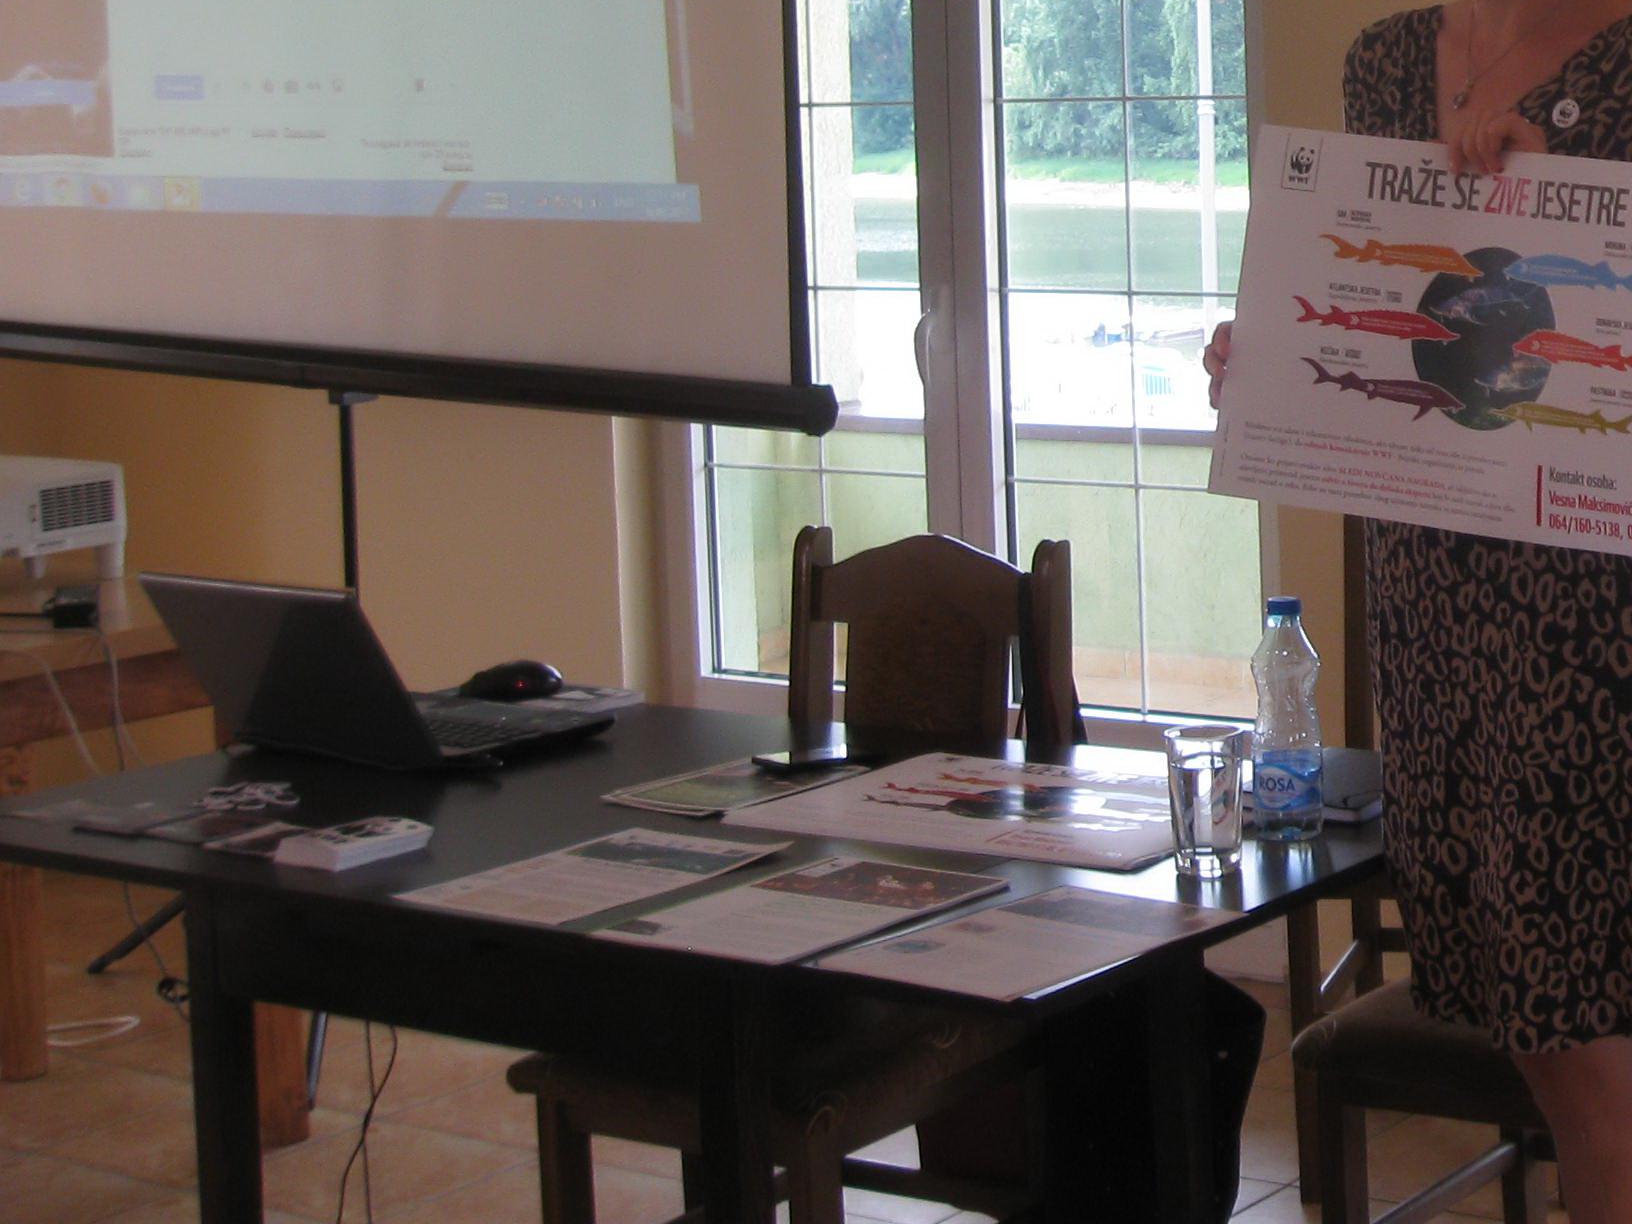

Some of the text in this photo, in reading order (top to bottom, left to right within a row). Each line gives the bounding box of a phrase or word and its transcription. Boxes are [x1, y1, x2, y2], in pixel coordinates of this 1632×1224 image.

[1365, 158, 1448, 207] TRAŽE
[1452, 173, 1484, 211] SE
[1530, 179, 1630, 227] JESETRE
[1550, 466, 1584, 486] Kontakt
[1549, 490, 1577, 508] Vesna
